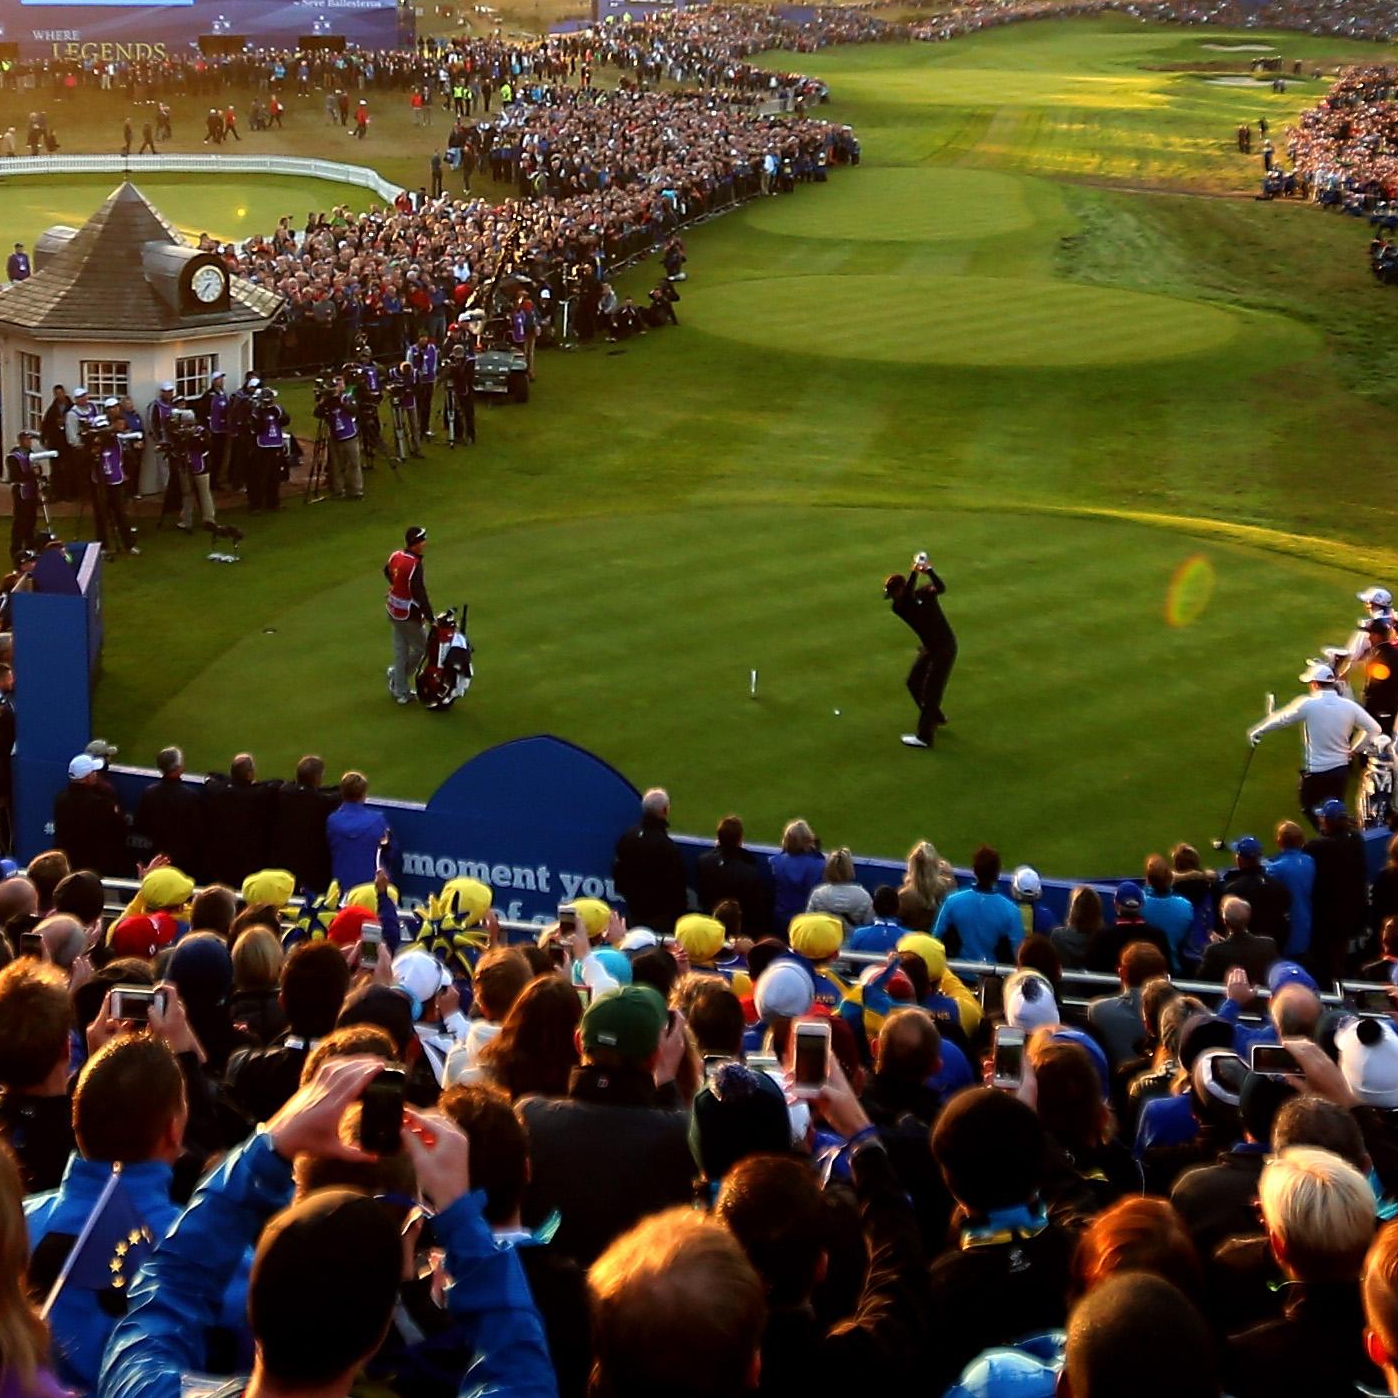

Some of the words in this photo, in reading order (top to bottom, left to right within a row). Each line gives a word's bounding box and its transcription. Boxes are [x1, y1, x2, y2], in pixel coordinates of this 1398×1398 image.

[32, 30, 80, 41] WHERE
[53, 43, 166, 61] LEGENDS
[402, 853, 551, 893] moment
